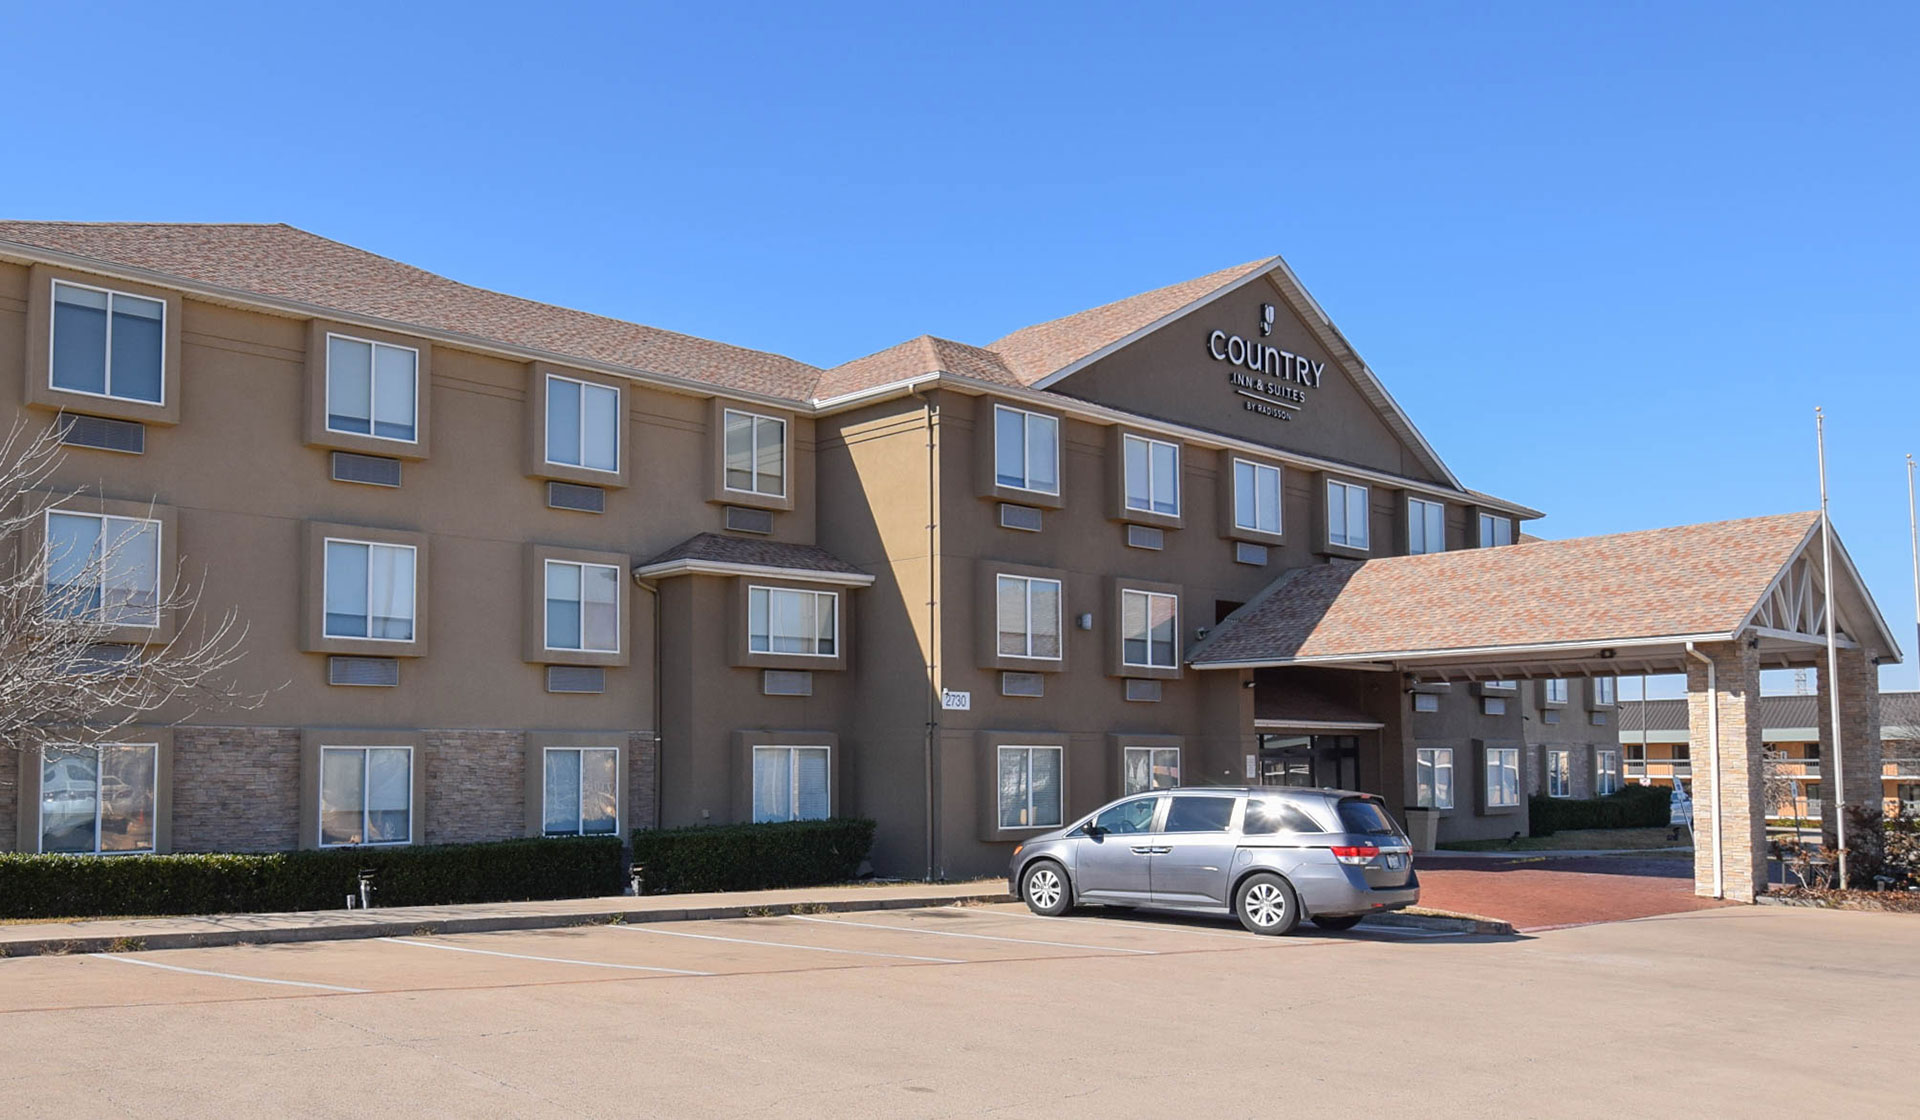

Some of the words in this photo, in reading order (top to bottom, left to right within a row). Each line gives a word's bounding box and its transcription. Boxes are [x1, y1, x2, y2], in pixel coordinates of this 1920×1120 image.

[1232, 372, 1253, 389] INN
[1256, 379, 1263, 391] &
[1267, 382, 1306, 403] SUITES
[1246, 401, 1256, 410] BY
[1257, 404, 1292, 421] RADISSON
[945, 694, 967, 707] 2730
